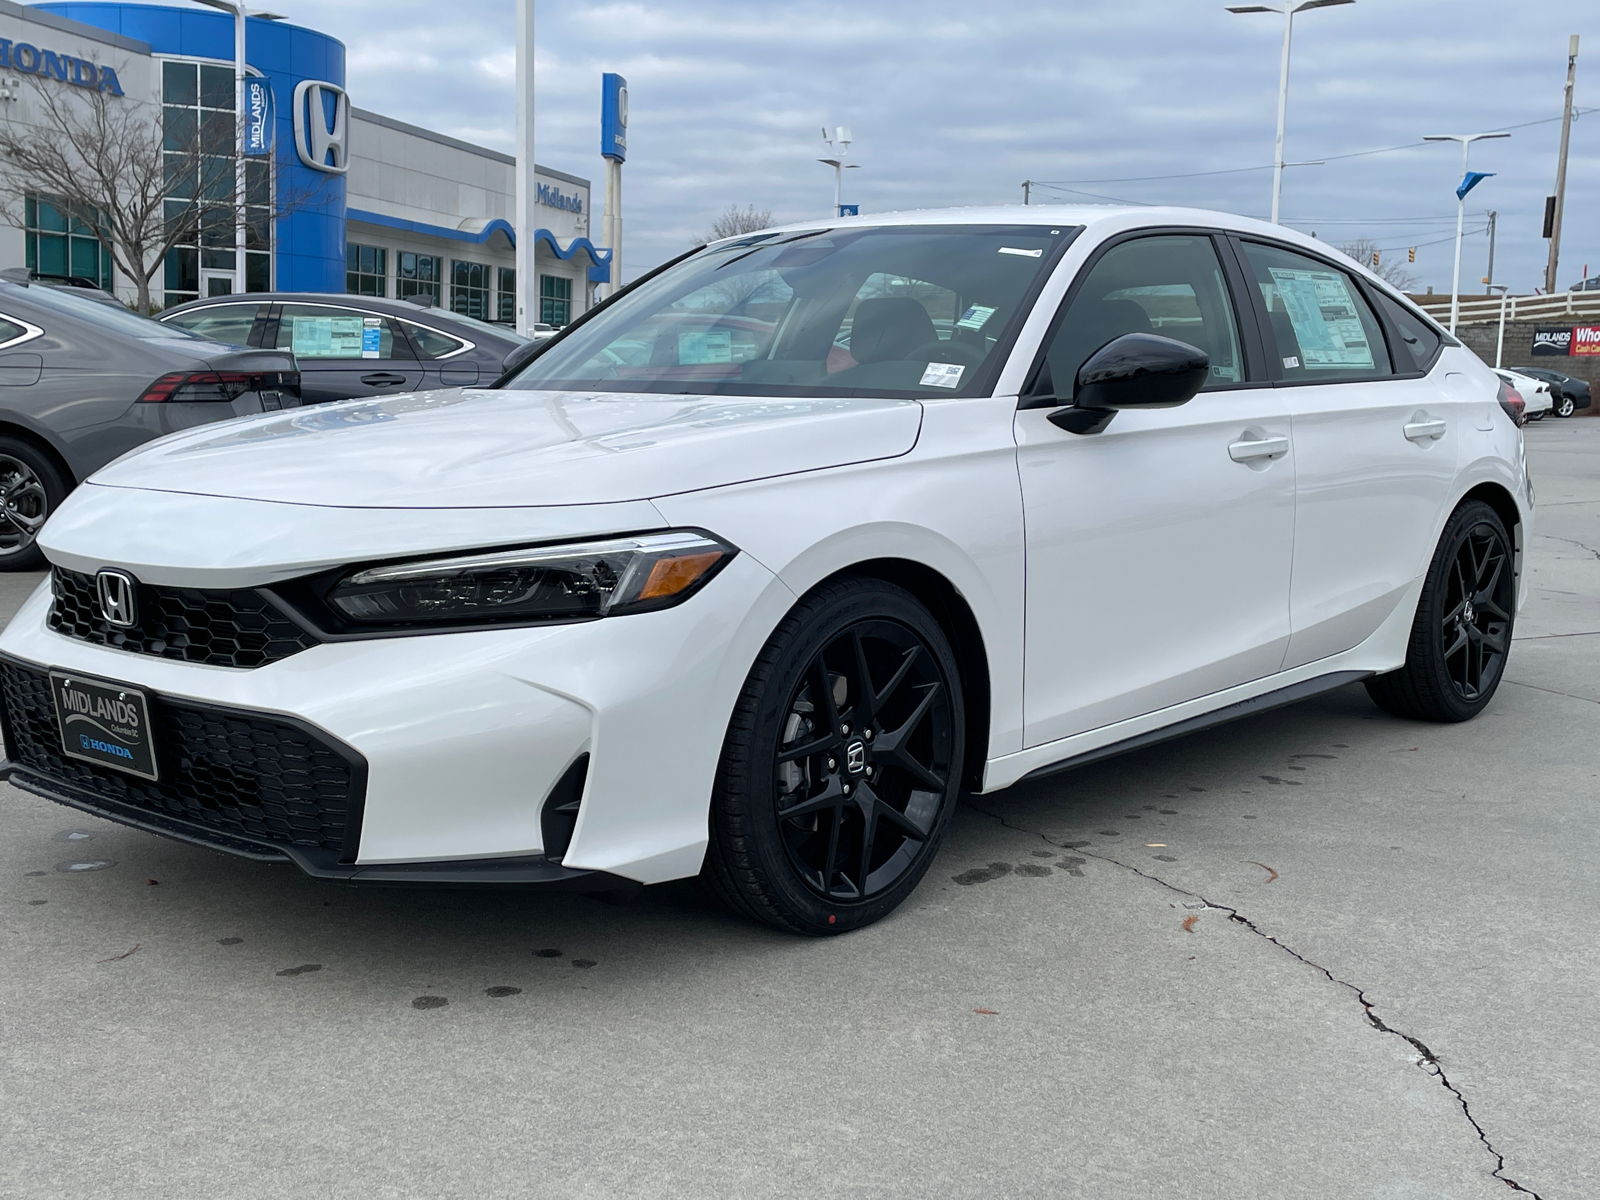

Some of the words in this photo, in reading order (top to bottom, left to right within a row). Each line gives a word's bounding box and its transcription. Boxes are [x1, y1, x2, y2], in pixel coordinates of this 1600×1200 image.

[250, 83, 261, 148] MIDLANDS
[537, 182, 583, 213] Midlands
[1535, 332, 1571, 341] MIDLANDS
[1576, 327, 1600, 343] Who
[61, 687, 139, 727] MIDLANDS
[90, 739, 134, 760] HONDA
